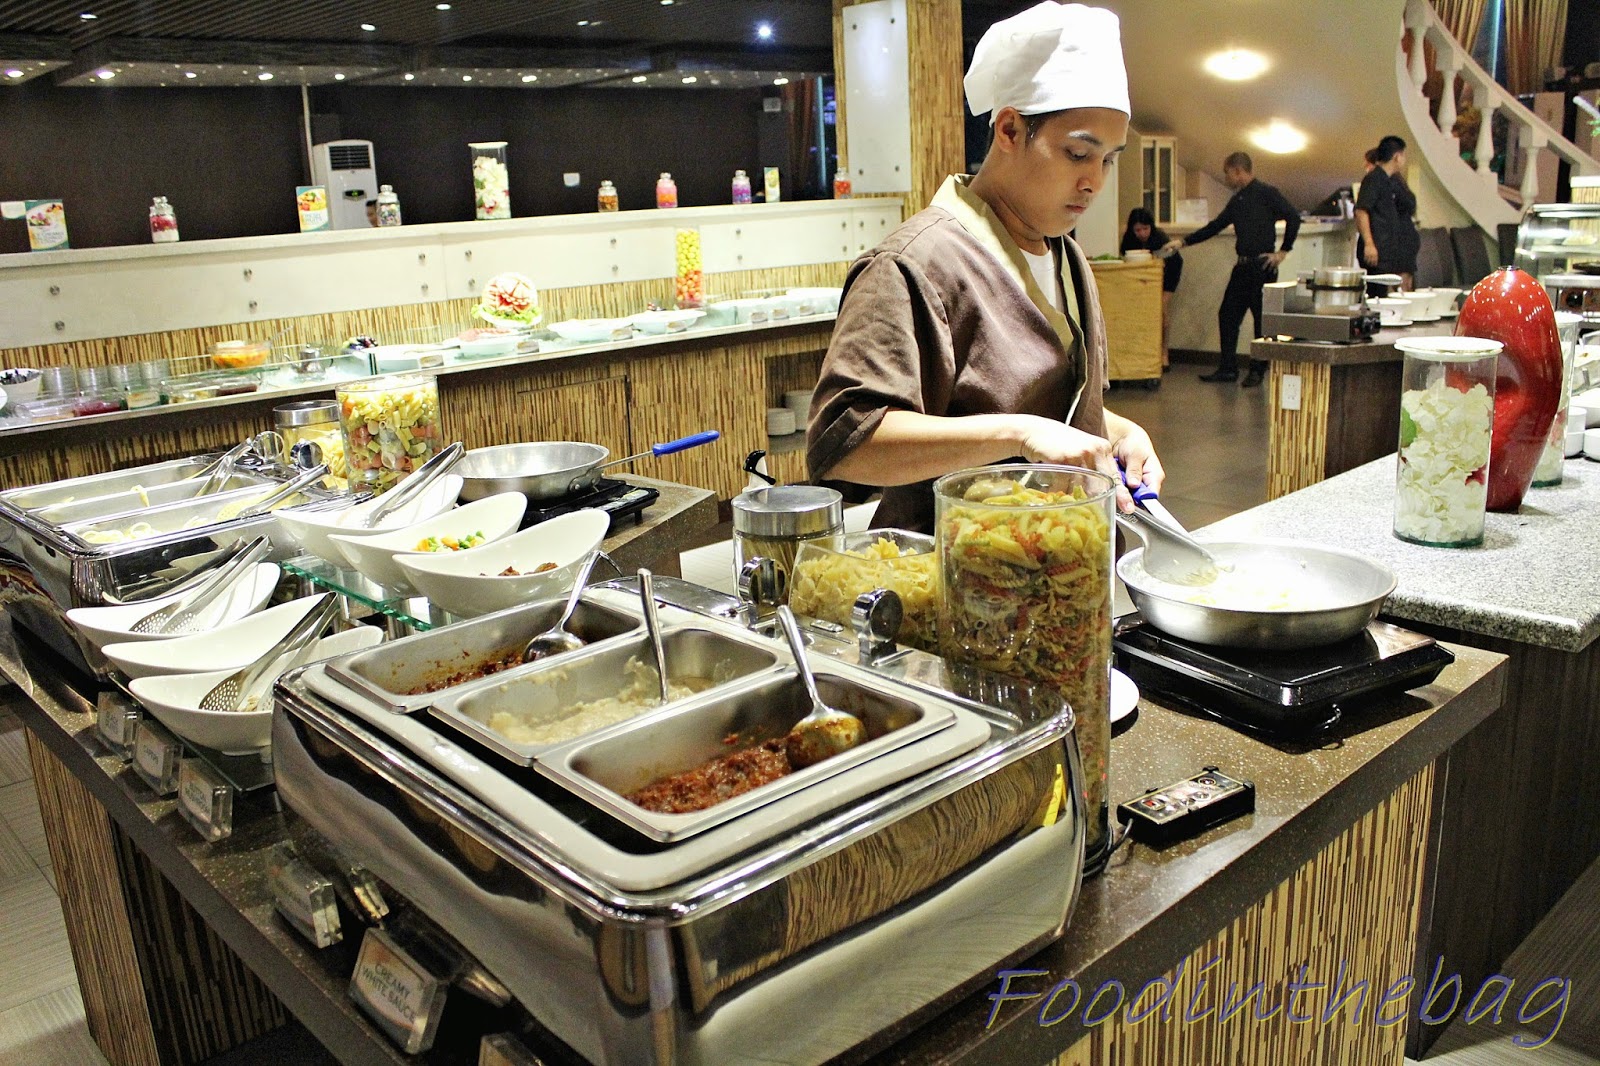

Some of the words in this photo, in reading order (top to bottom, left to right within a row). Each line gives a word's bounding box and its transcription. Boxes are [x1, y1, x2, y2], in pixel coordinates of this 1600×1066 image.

[362, 966, 389, 997] WHITE
[388, 990, 416, 1024] SAUCE
[375, 963, 410, 998] CREAMY
